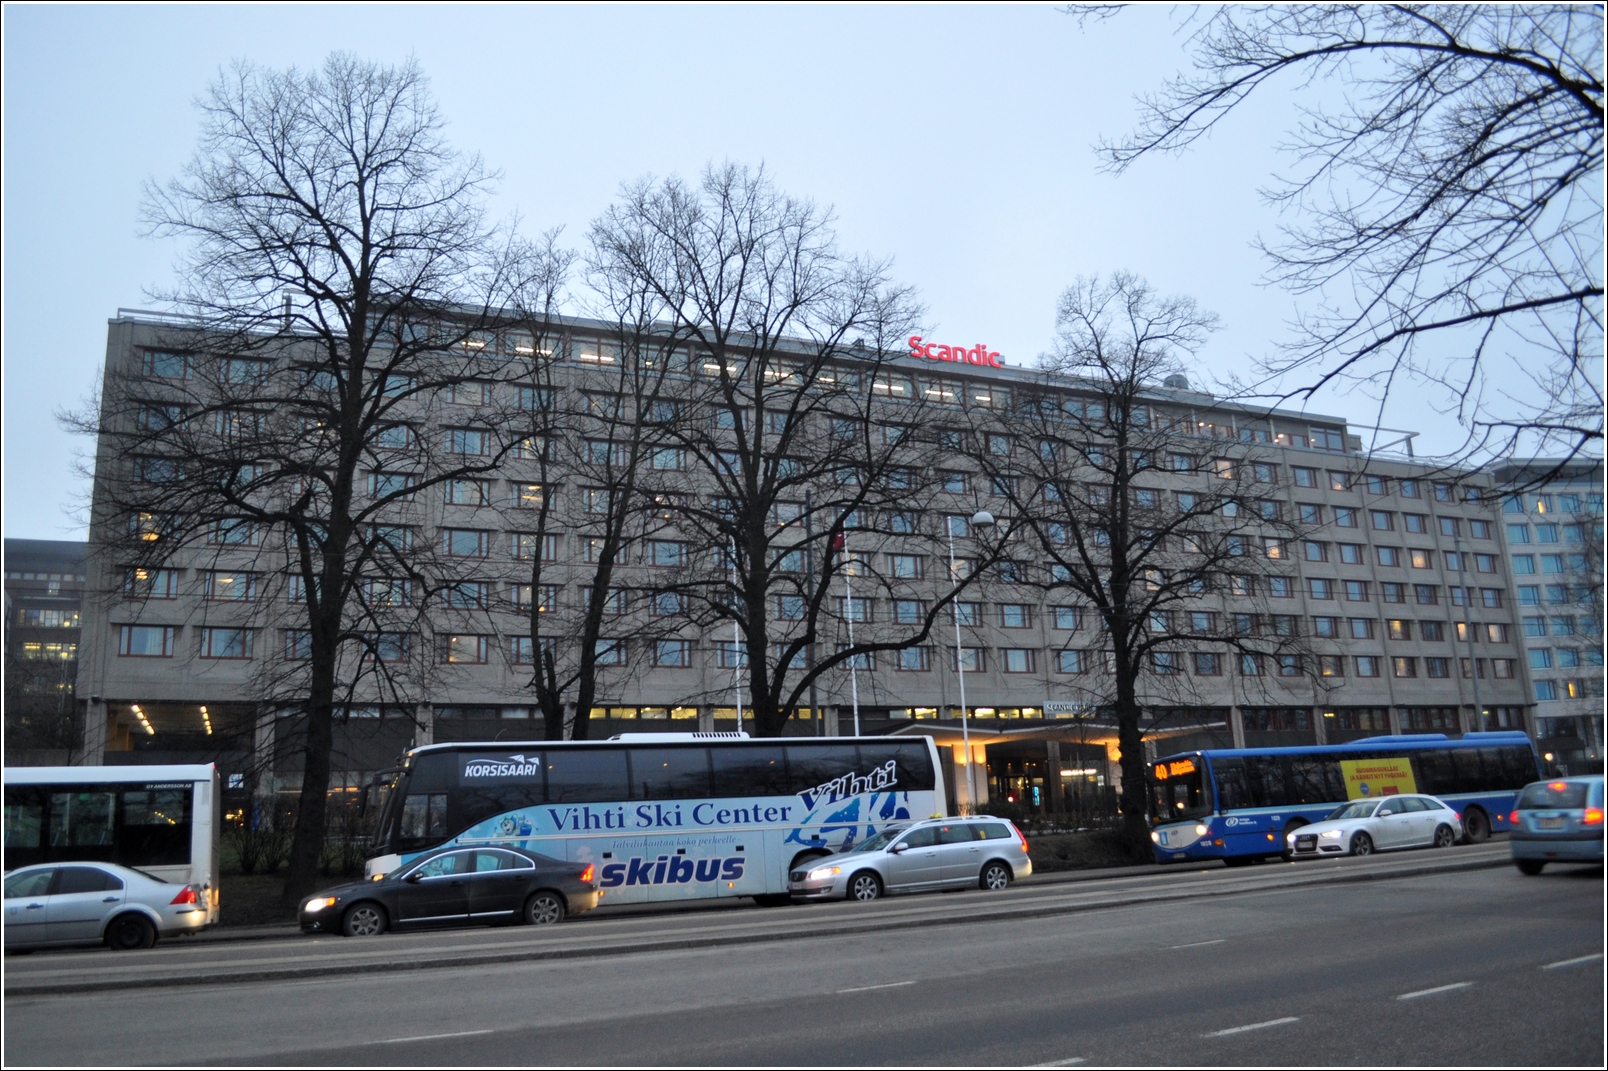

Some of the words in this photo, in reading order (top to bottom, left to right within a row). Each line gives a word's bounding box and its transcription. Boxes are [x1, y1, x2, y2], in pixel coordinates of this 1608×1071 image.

[908, 336, 1002, 368] Scandic
[464, 764, 537, 777] KORSISAARI
[1154, 764, 1168, 780] 40
[796, 760, 898, 813] Vihti
[547, 805, 626, 831] Vihti
[635, 803, 684, 828] Ski
[692, 802, 792, 826] Center
[676, 837, 697, 846] koko
[600, 856, 746, 887] skibus
